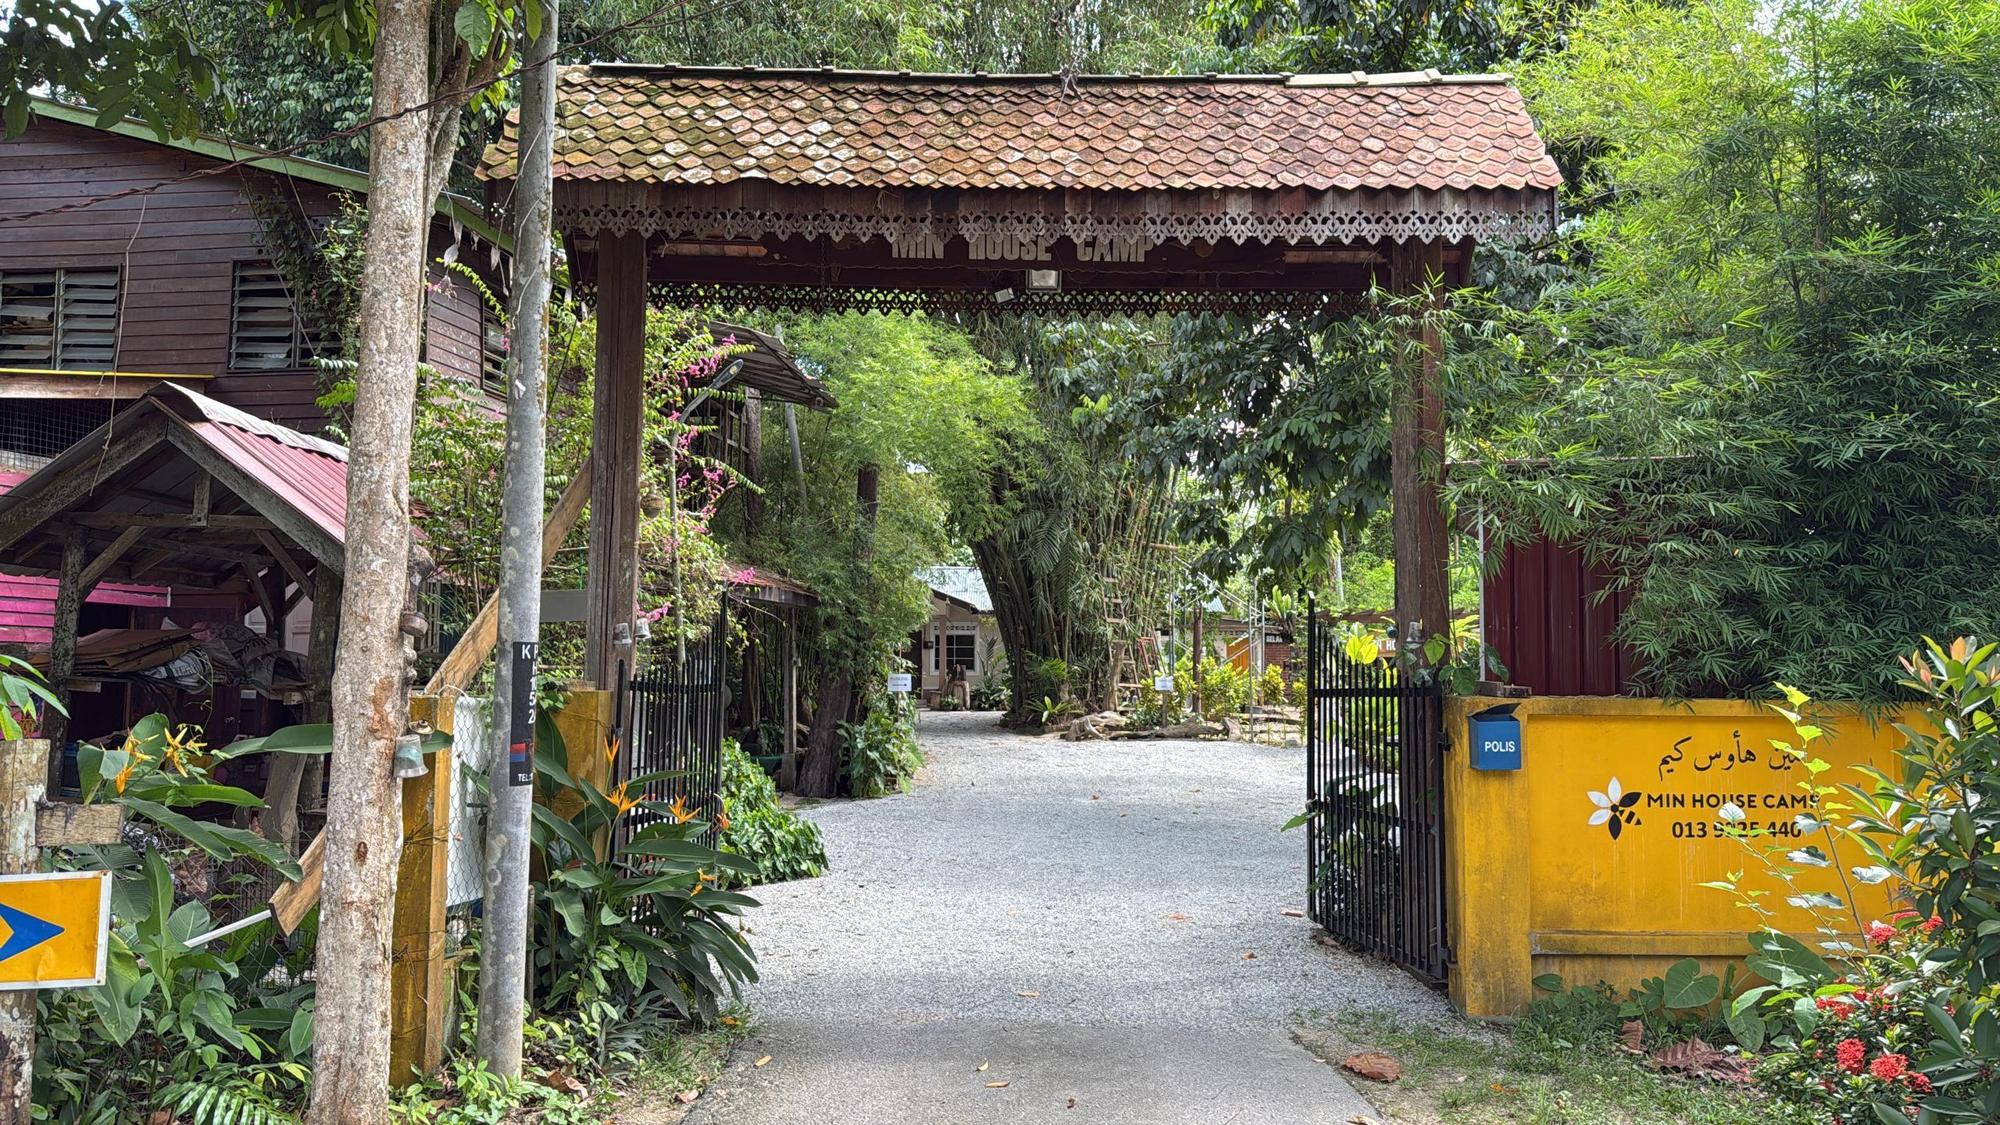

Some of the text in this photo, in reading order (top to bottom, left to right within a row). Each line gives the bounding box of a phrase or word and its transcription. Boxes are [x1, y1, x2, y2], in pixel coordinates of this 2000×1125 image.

[891, 233, 1154, 262] MIN HOUSE CAMP
[1484, 740, 1516, 753] POLIS
[1647, 793, 1821, 809] MIN HOUSE CAMP
[1672, 821, 1708, 839] 013
[1766, 821, 1802, 839] 440
